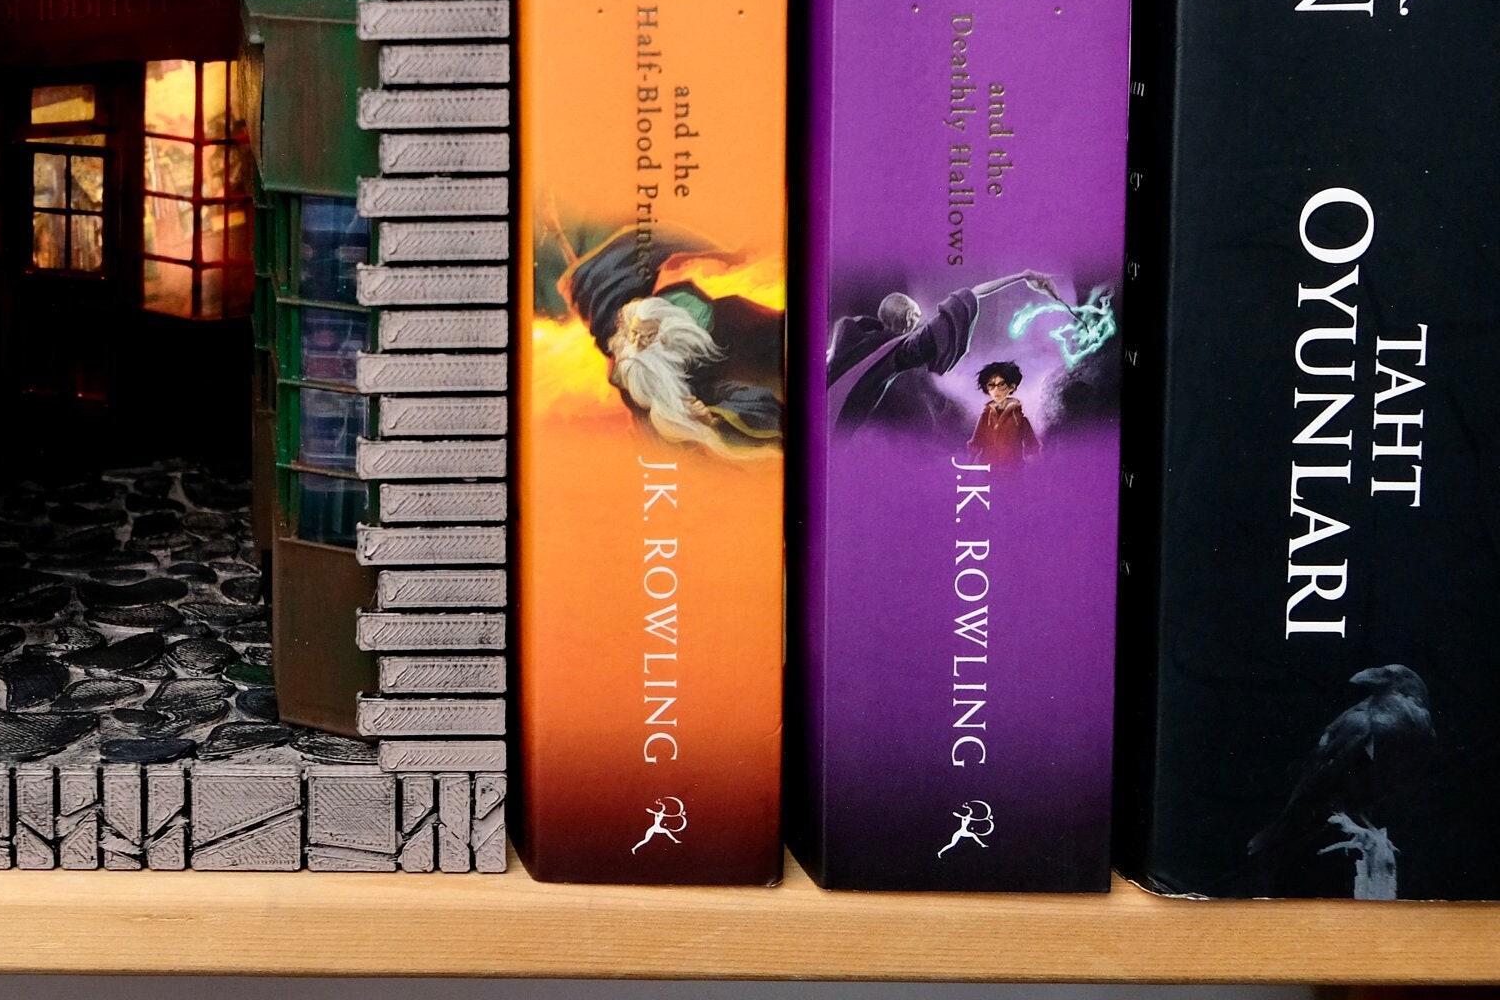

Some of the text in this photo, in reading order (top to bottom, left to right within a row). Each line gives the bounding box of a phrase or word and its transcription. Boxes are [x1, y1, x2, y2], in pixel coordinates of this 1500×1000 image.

[636, 6, 662, 171] Half-Blood
[674, 85, 699, 198] and the
[943, 13, 976, 266] Deathly Hallows
[987, 82, 1015, 197] and the
[1285, 187, 1376, 640] OYUNLARI
[1371, 323, 1428, 508] TAHT
[638, 456, 678, 764] J.K. ROWLING
[951, 456, 991, 768] J.K. ROWLING
